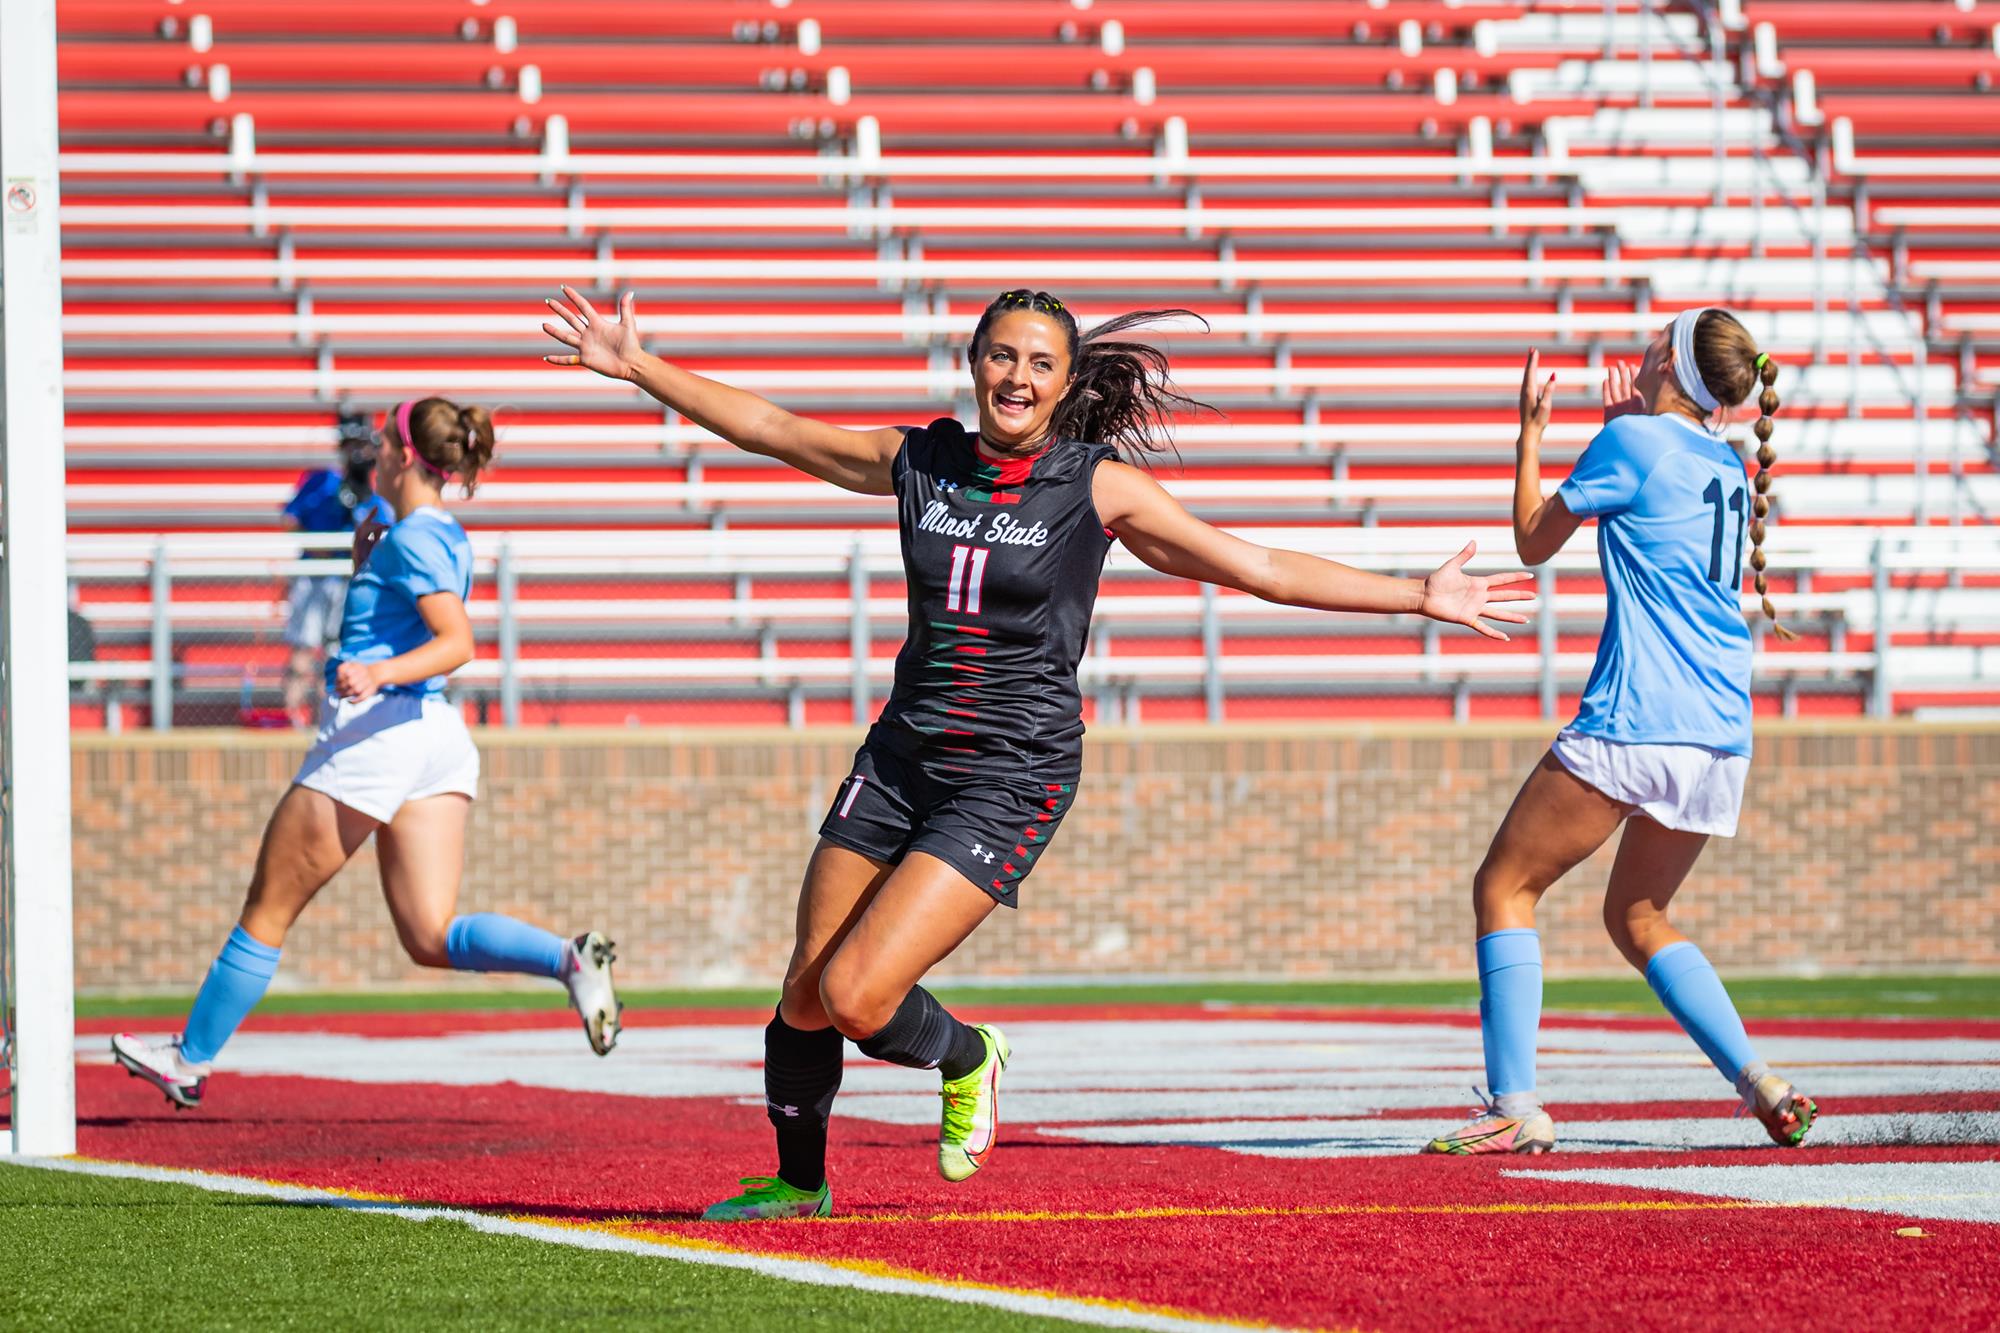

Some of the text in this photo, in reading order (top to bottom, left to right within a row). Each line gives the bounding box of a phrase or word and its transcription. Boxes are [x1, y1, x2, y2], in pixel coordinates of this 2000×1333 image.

[919, 501, 1047, 547] Minot State
[1703, 477, 1744, 591] 11
[946, 544, 991, 615] 11
[838, 774, 867, 820] 1
